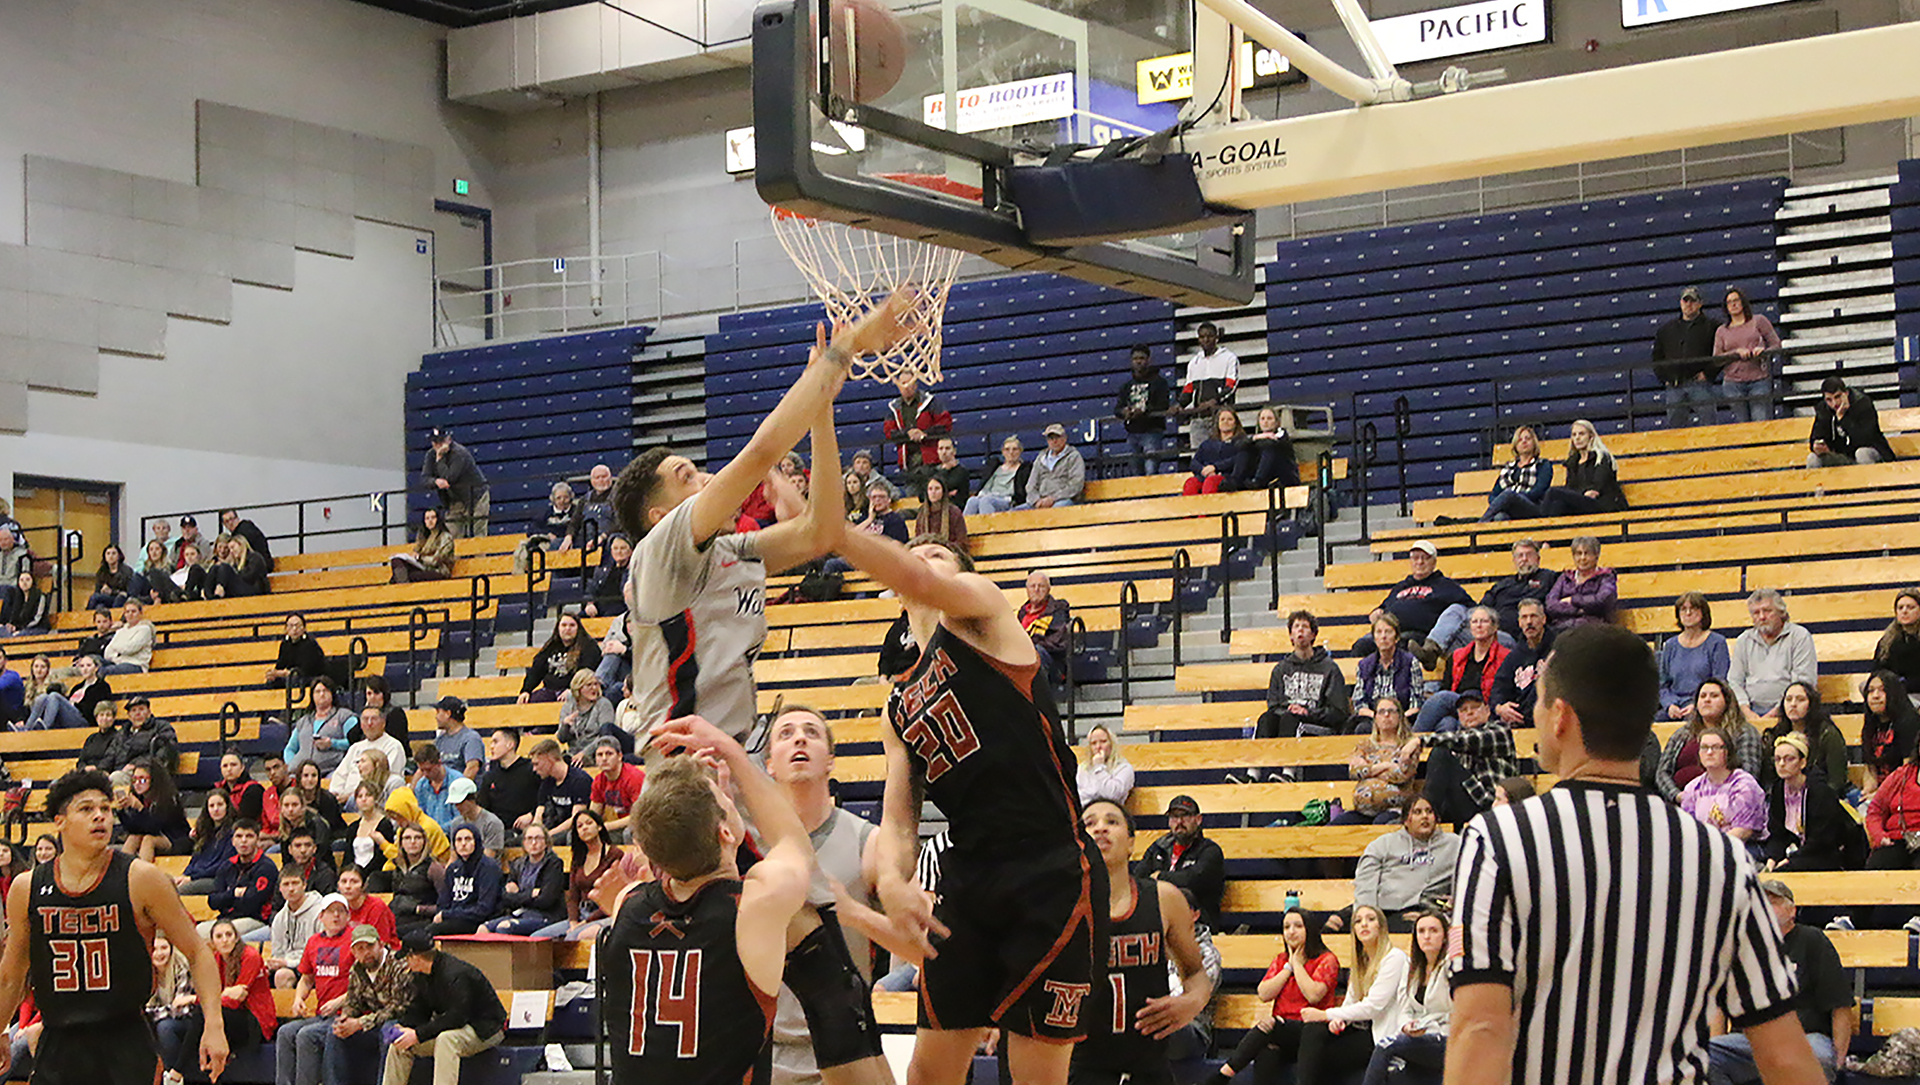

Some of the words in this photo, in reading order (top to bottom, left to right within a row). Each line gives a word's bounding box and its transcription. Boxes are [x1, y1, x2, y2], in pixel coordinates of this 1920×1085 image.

[1420, 3, 1528, 42] PACIFIC
[930, 80, 1066, 114] RTO-ROOTER
[1205, 164, 1242, 179] SPORTS
[1244, 158, 1287, 173] SYSTEMS
[1084, 419, 1095, 442] J
[370, 492, 383, 512] K
[902, 688, 981, 784] 20
[37, 903, 120, 934] TECH
[48, 938, 111, 991] 30
[628, 948, 702, 1058] 14
[1108, 972, 1126, 1034] 1
